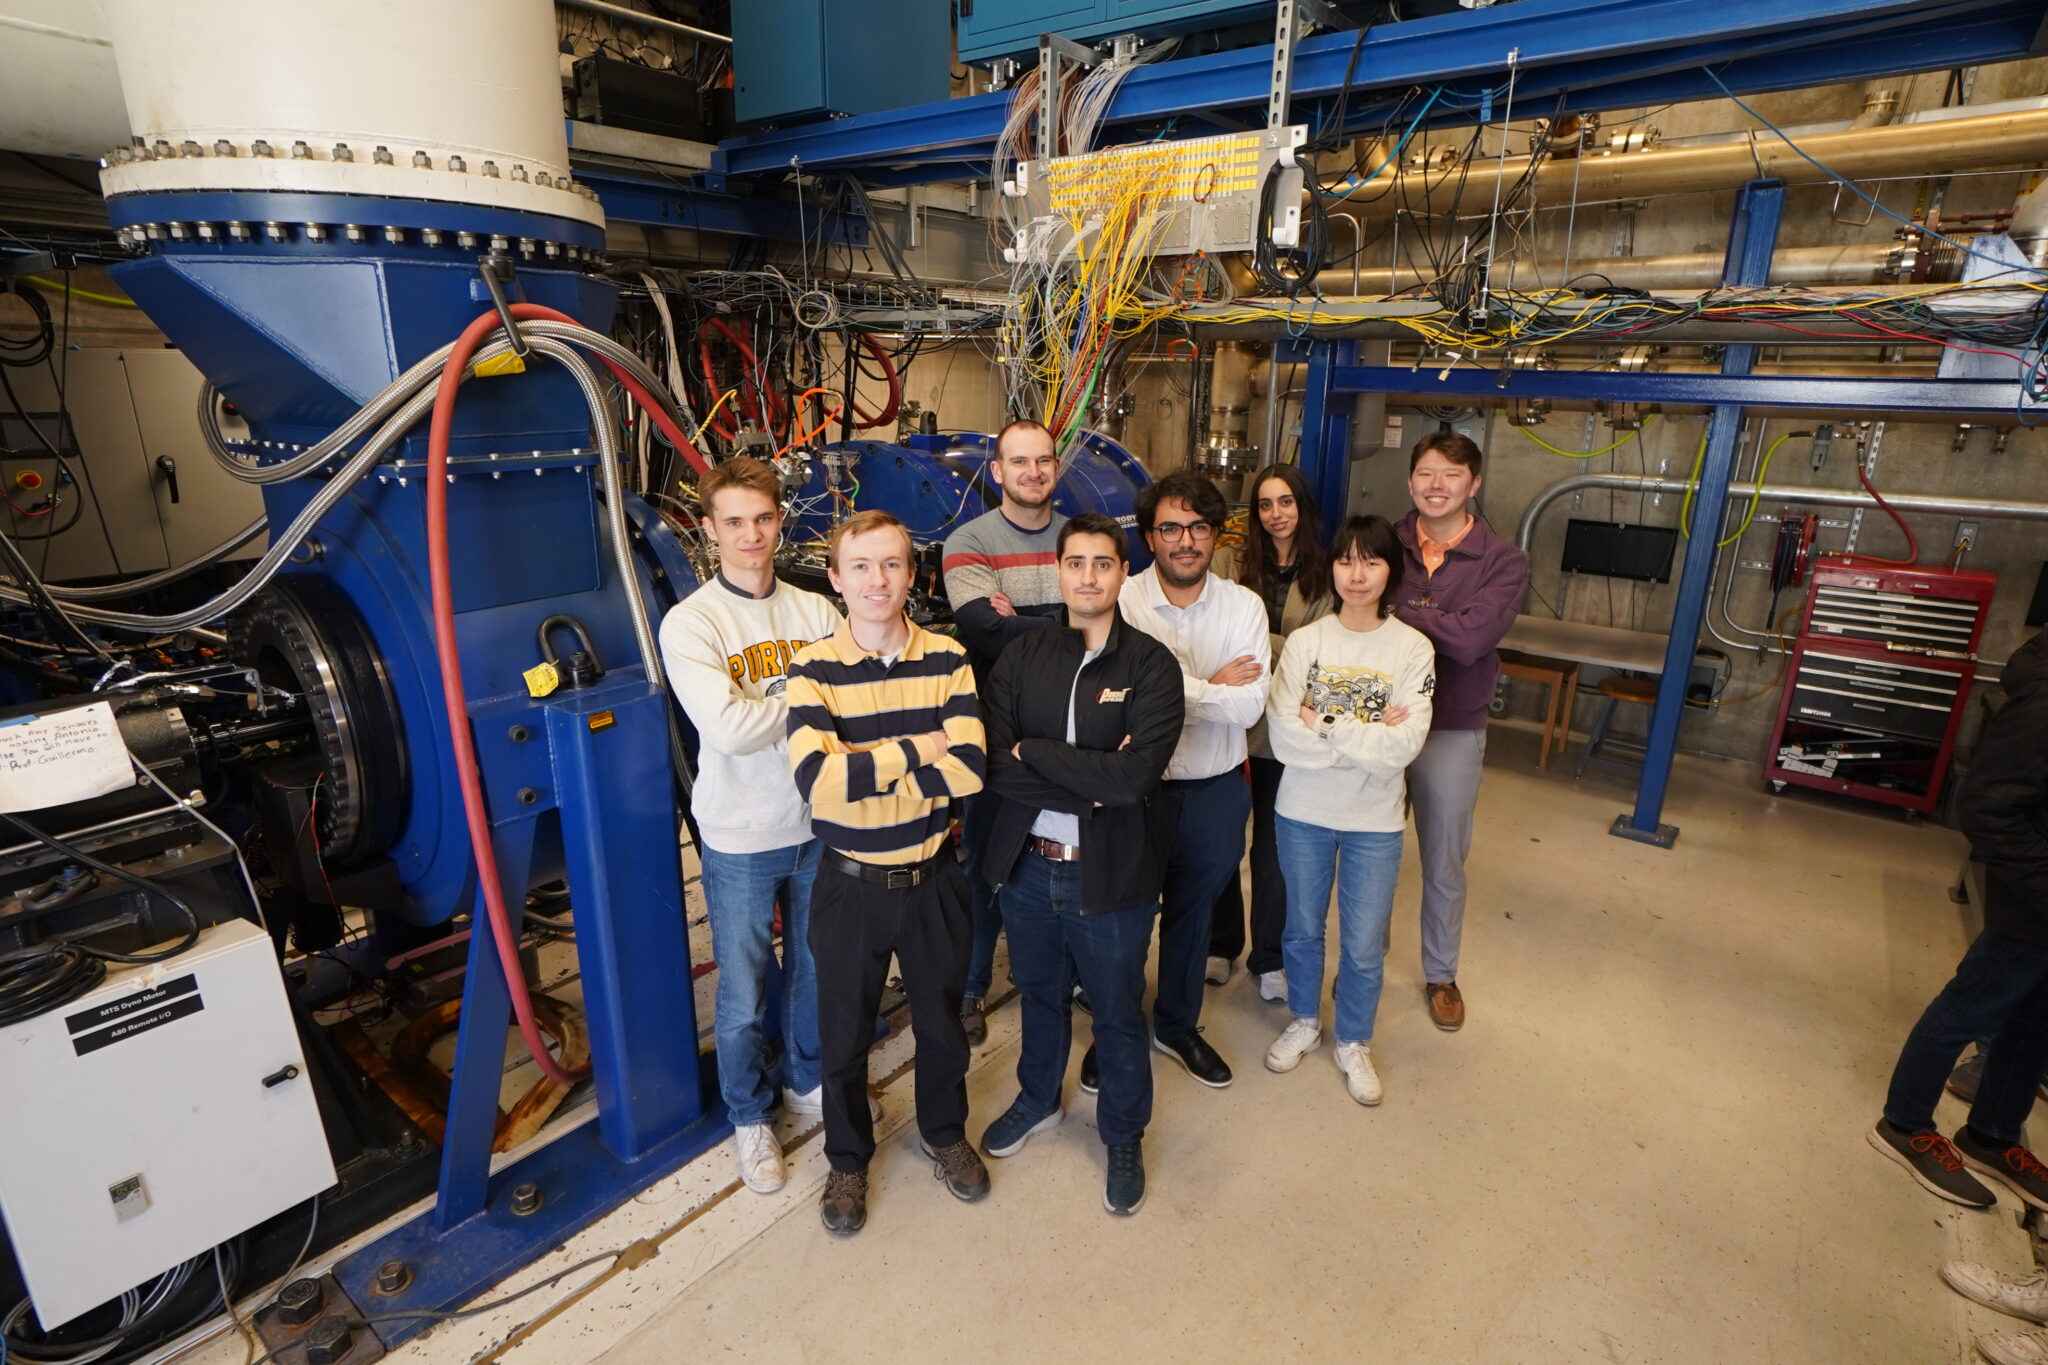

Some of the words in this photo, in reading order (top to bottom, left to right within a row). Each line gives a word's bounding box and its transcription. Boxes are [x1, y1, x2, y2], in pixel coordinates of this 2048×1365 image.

[727, 640, 809, 690] PURD
[55, 720, 97, 731] Sensors
[9, 737, 49, 748] asking
[54, 727, 99, 741] Antonio
[38, 747, 95, 765] Guillermo
[100, 1005, 120, 1017] MTS
[121, 998, 142, 1009] Dyno
[142, 989, 167, 1002] Motor
[128, 1017, 158, 1032] Remote
[159, 1011, 172, 1020] I/O
